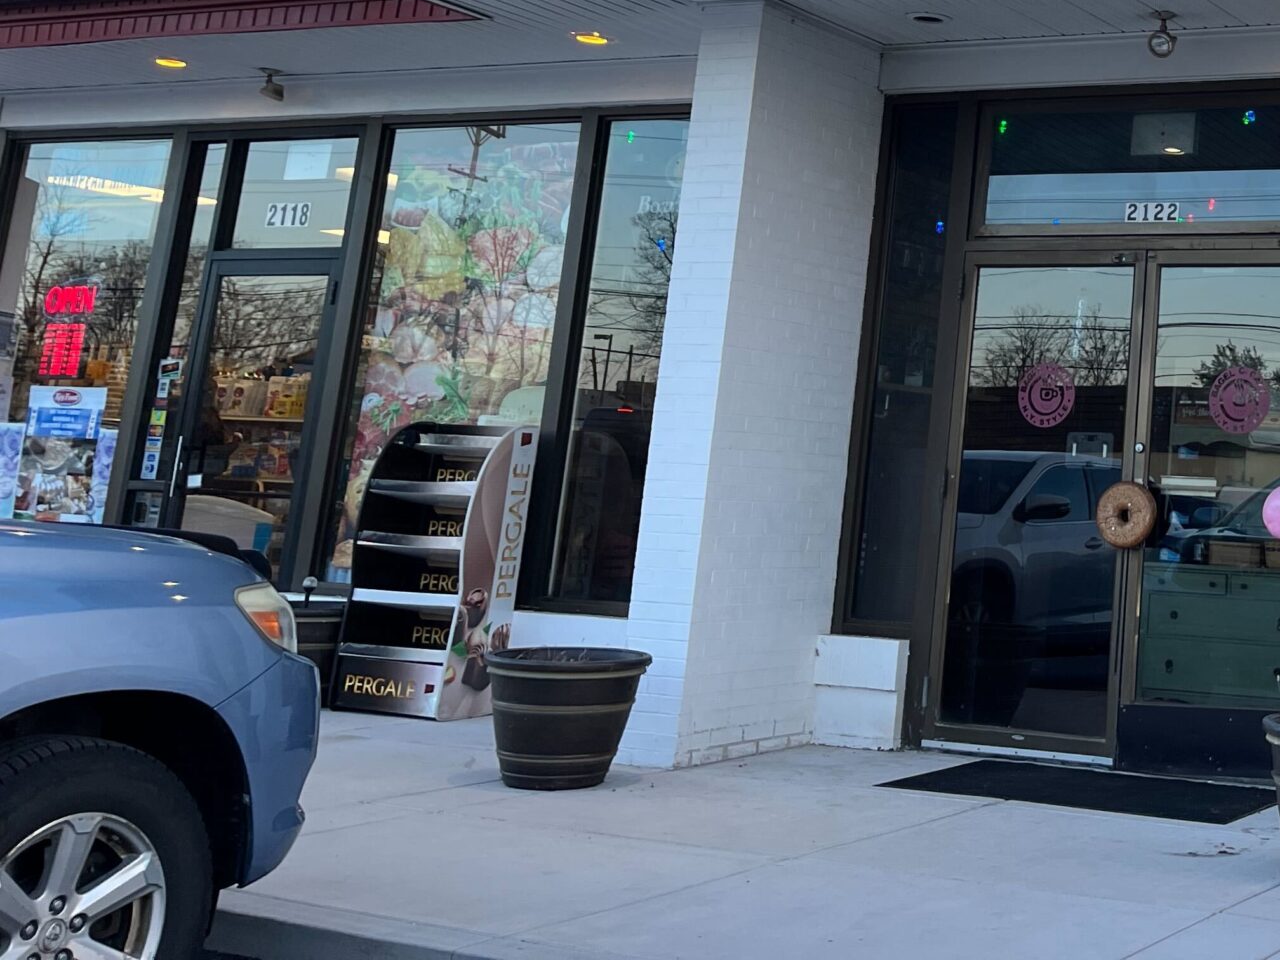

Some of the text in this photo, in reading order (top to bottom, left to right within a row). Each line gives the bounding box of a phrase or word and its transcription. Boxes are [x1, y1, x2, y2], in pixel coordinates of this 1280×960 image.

[266, 203, 310, 226] 2118
[1127, 203, 1178, 221] 2122
[45, 286, 97, 314] OPEN
[496, 463, 531, 600] PERGALE
[344, 673, 416, 700] PERGALE
